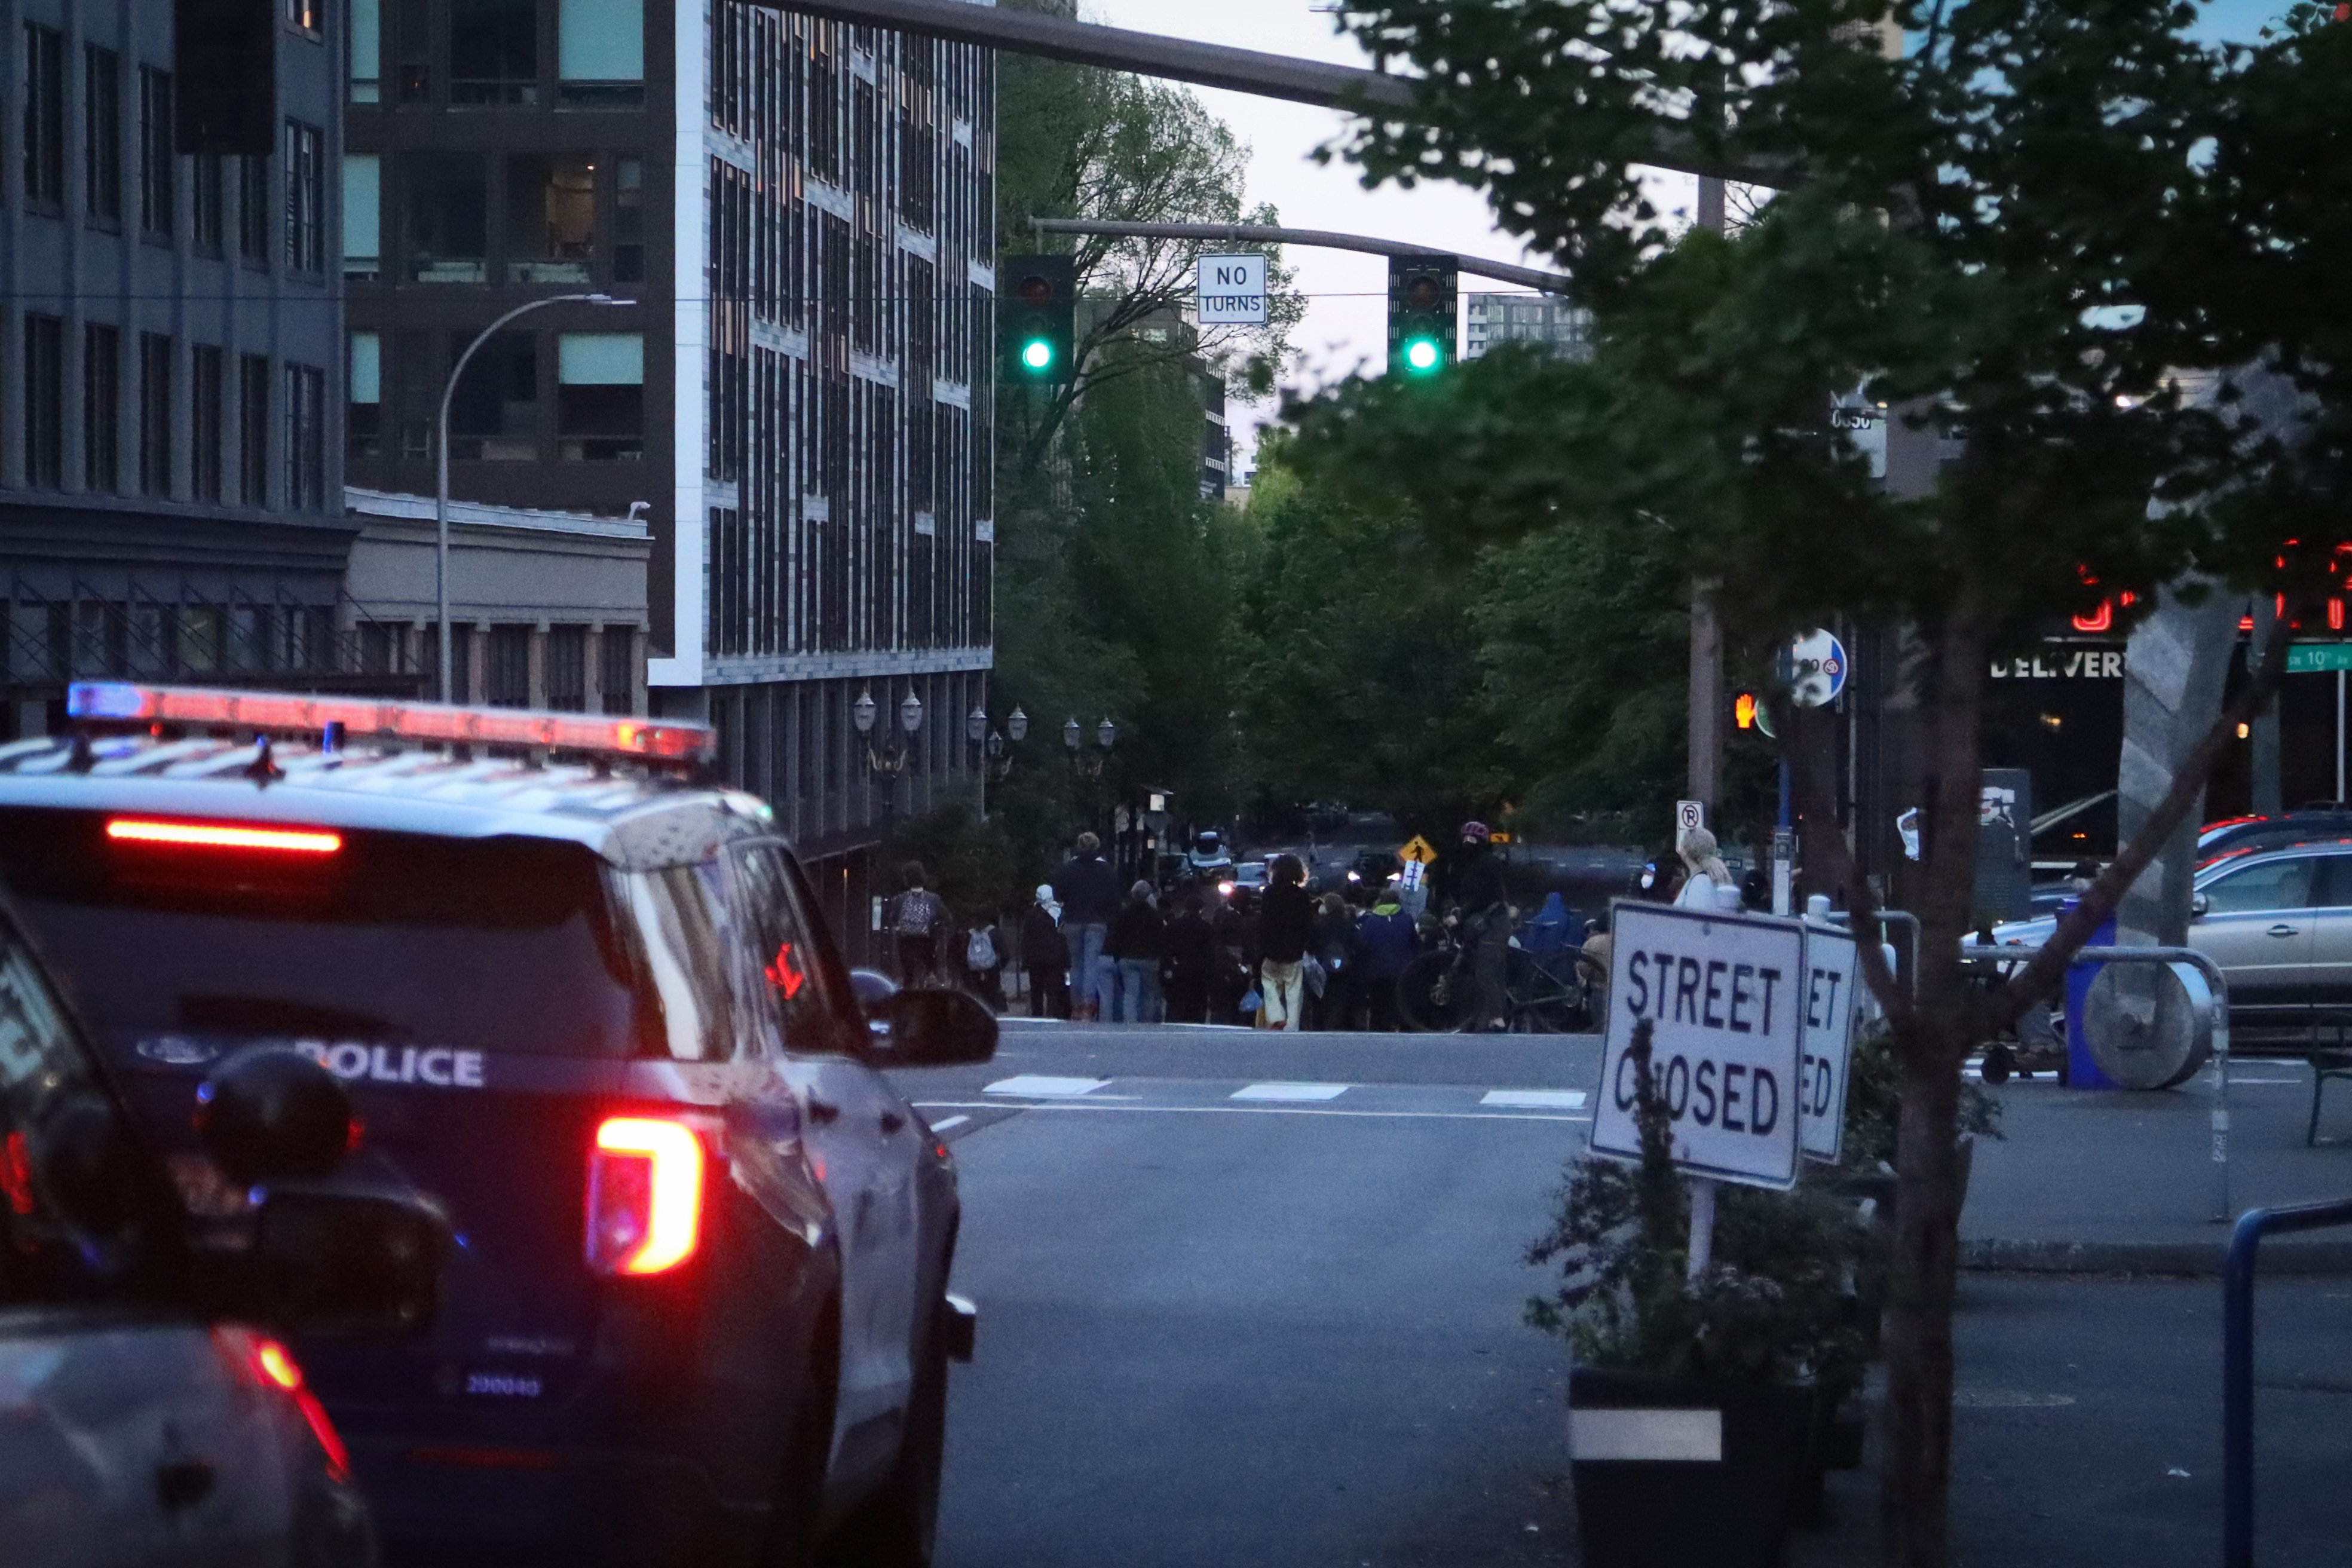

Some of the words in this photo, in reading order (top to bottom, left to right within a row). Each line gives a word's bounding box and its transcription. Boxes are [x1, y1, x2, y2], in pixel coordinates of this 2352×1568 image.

[1217, 267, 1247, 285] NO
[1203, 296, 1260, 311] TURNS
[1627, 950, 1781, 1036] STREET
[1615, 1046, 1779, 1136] COSED
